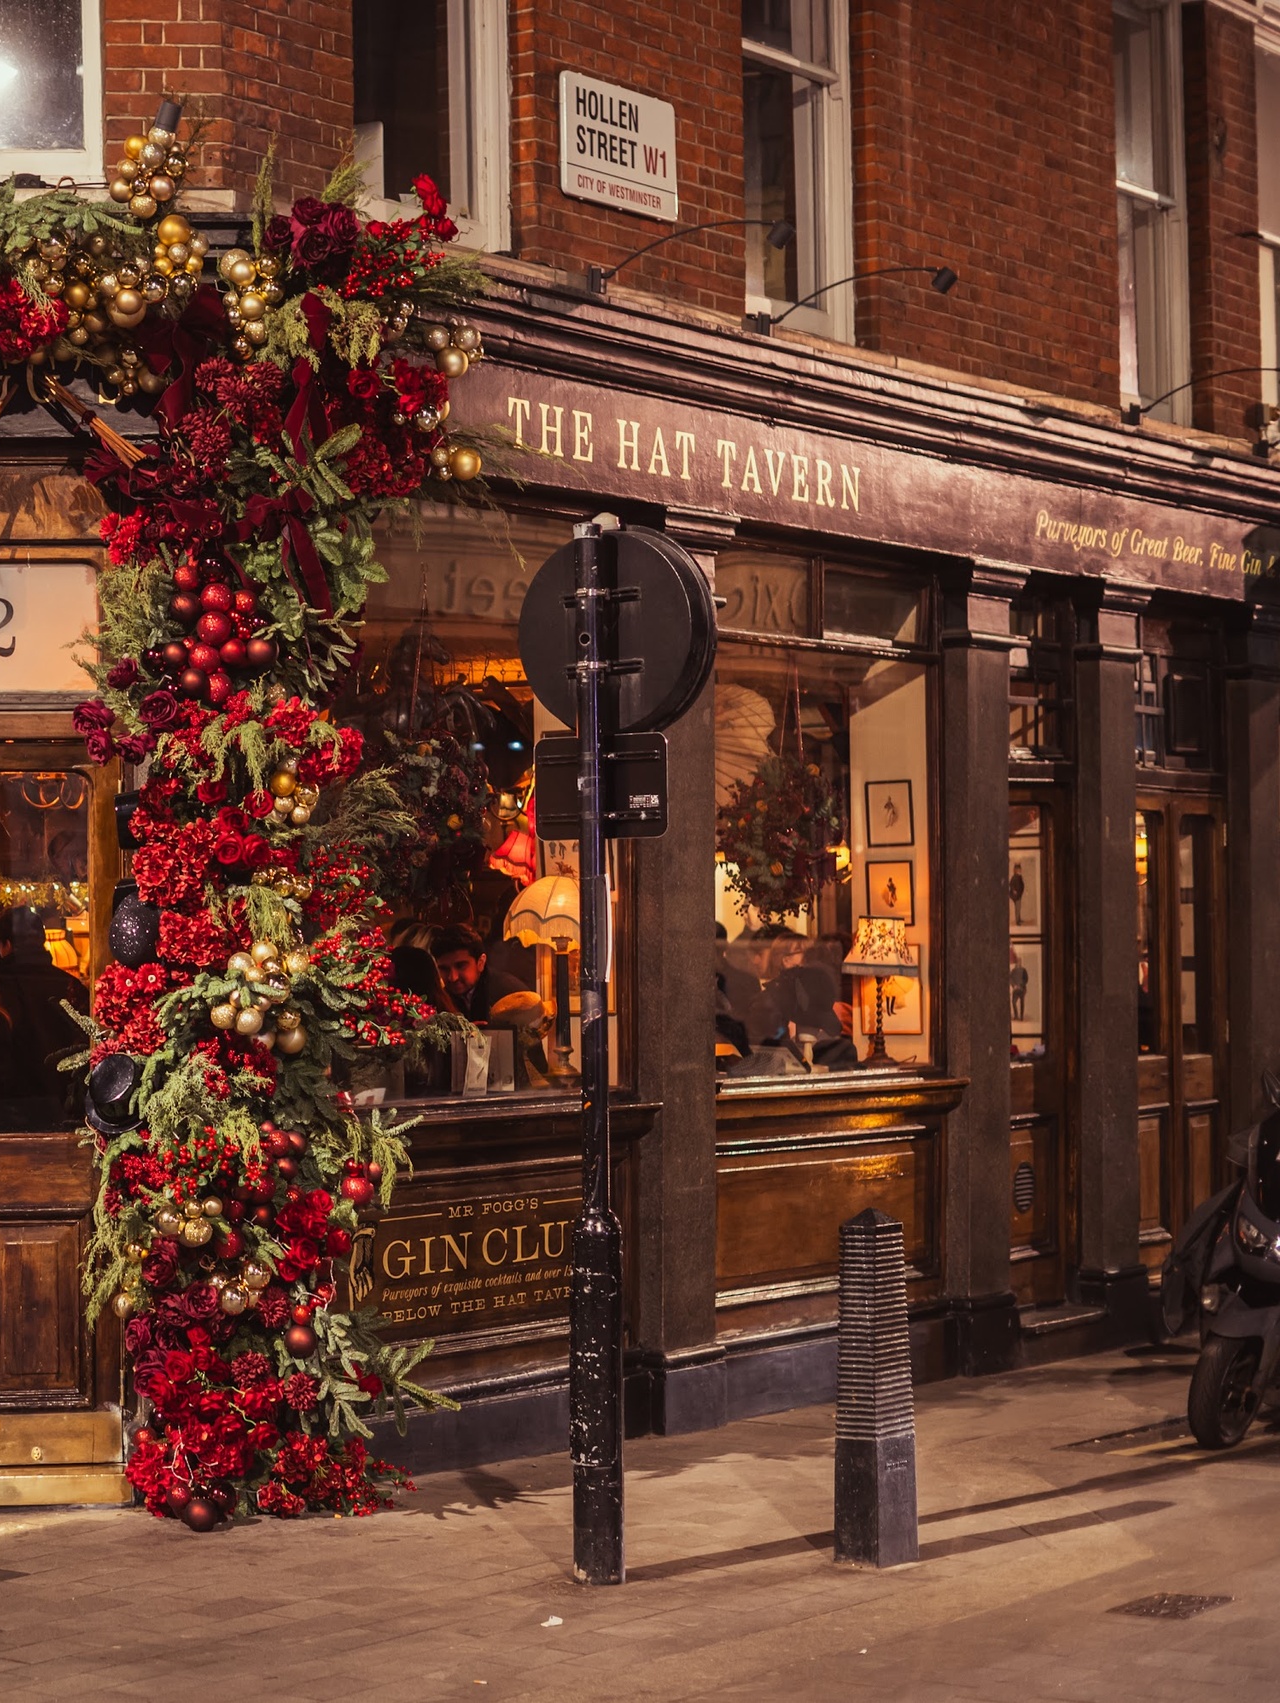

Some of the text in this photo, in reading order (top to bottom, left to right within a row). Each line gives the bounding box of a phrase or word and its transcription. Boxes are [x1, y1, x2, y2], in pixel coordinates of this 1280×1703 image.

[575, 86, 639, 133] HOLLEN
[576, 124, 667, 178] STREET W1
[577, 174, 662, 210] CITY OF WESTMINSTER
[507, 396, 861, 512] THE HAT TAVERN
[1034, 509, 1108, 552] Purveyors
[1110, 527, 1129, 558] of
[1130, 528, 1169, 559] Great
[1209, 542, 1237, 571] Fine
[1240, 549, 1262, 575] Gin
[448, 1197, 539, 1219] MR FOGG'S
[382, 1219, 573, 1280] GIN CLU
[382, 1264, 574, 1302] Purveyors of exquisite cocktails and over 15
[450, 1299, 486, 1315] THE
[493, 1292, 528, 1308] HAT
[533, 1286, 570, 1302] TAVE
